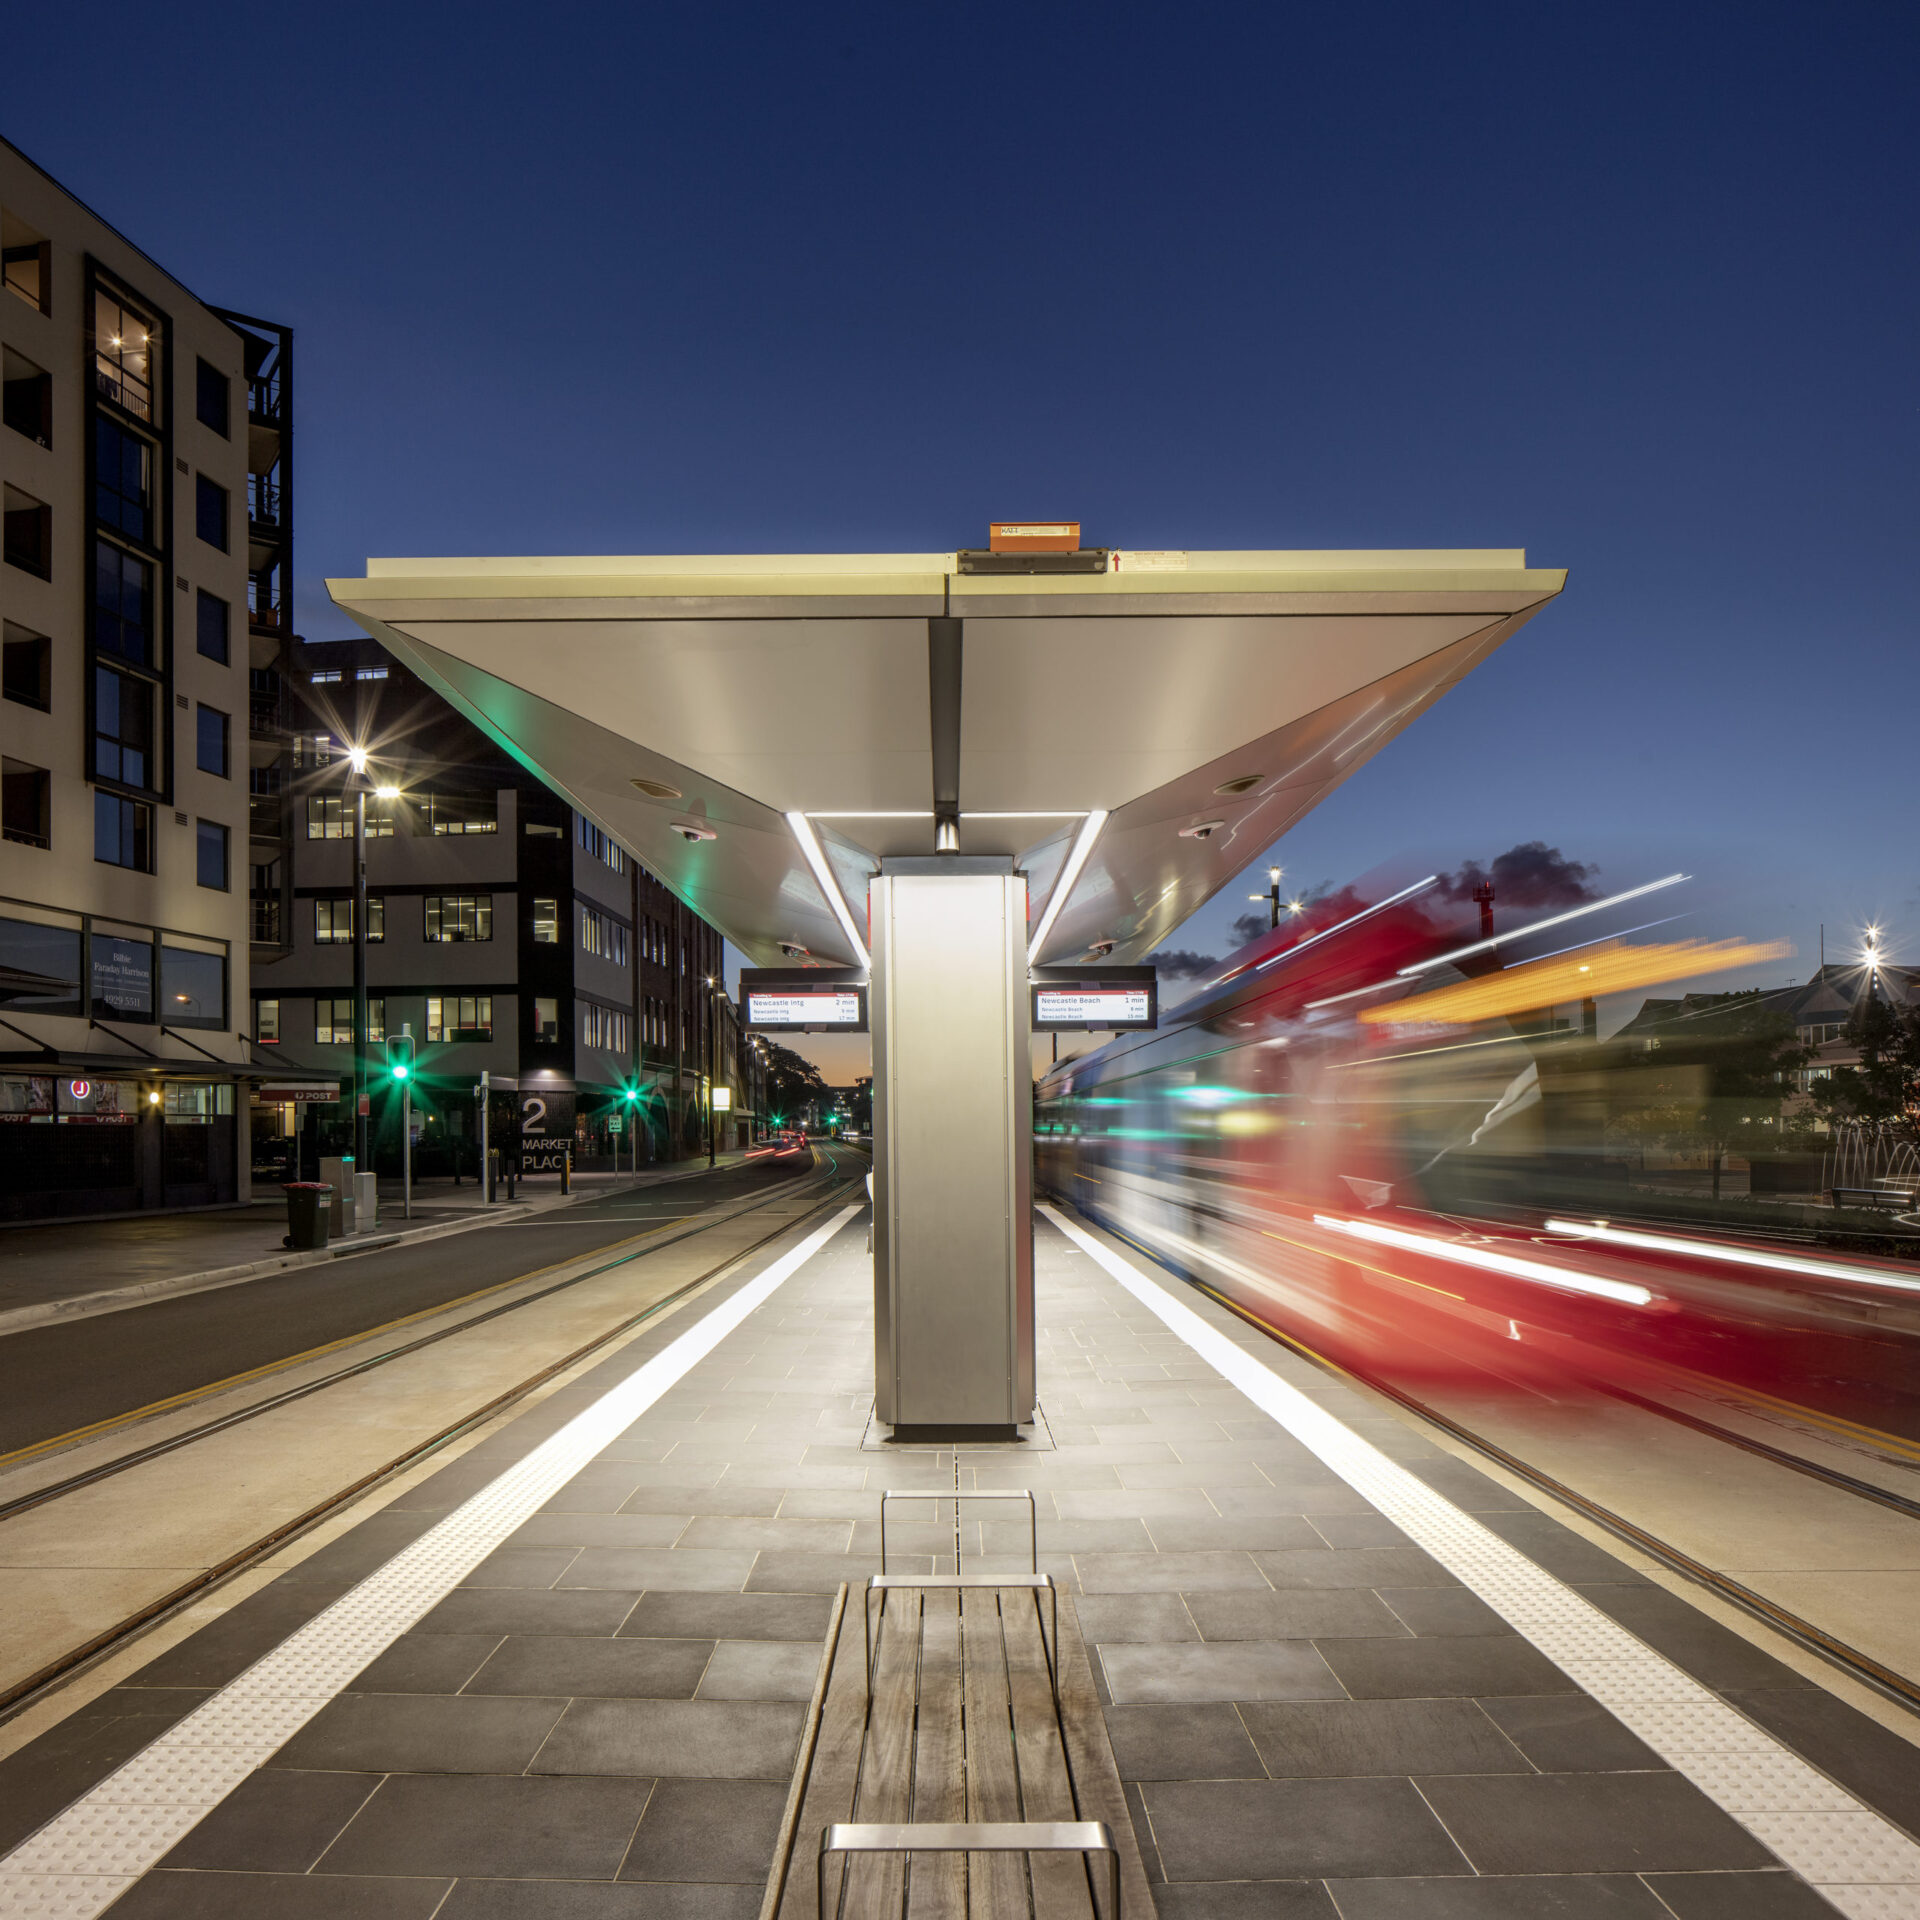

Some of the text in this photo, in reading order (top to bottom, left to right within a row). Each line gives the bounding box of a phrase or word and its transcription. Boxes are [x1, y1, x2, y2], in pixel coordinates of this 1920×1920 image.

[122, 965, 150, 978] Harrison
[305, 1092, 332, 1100] POST
[522, 1098, 547, 1133] 2
[522, 1139, 573, 1150] MARKET
